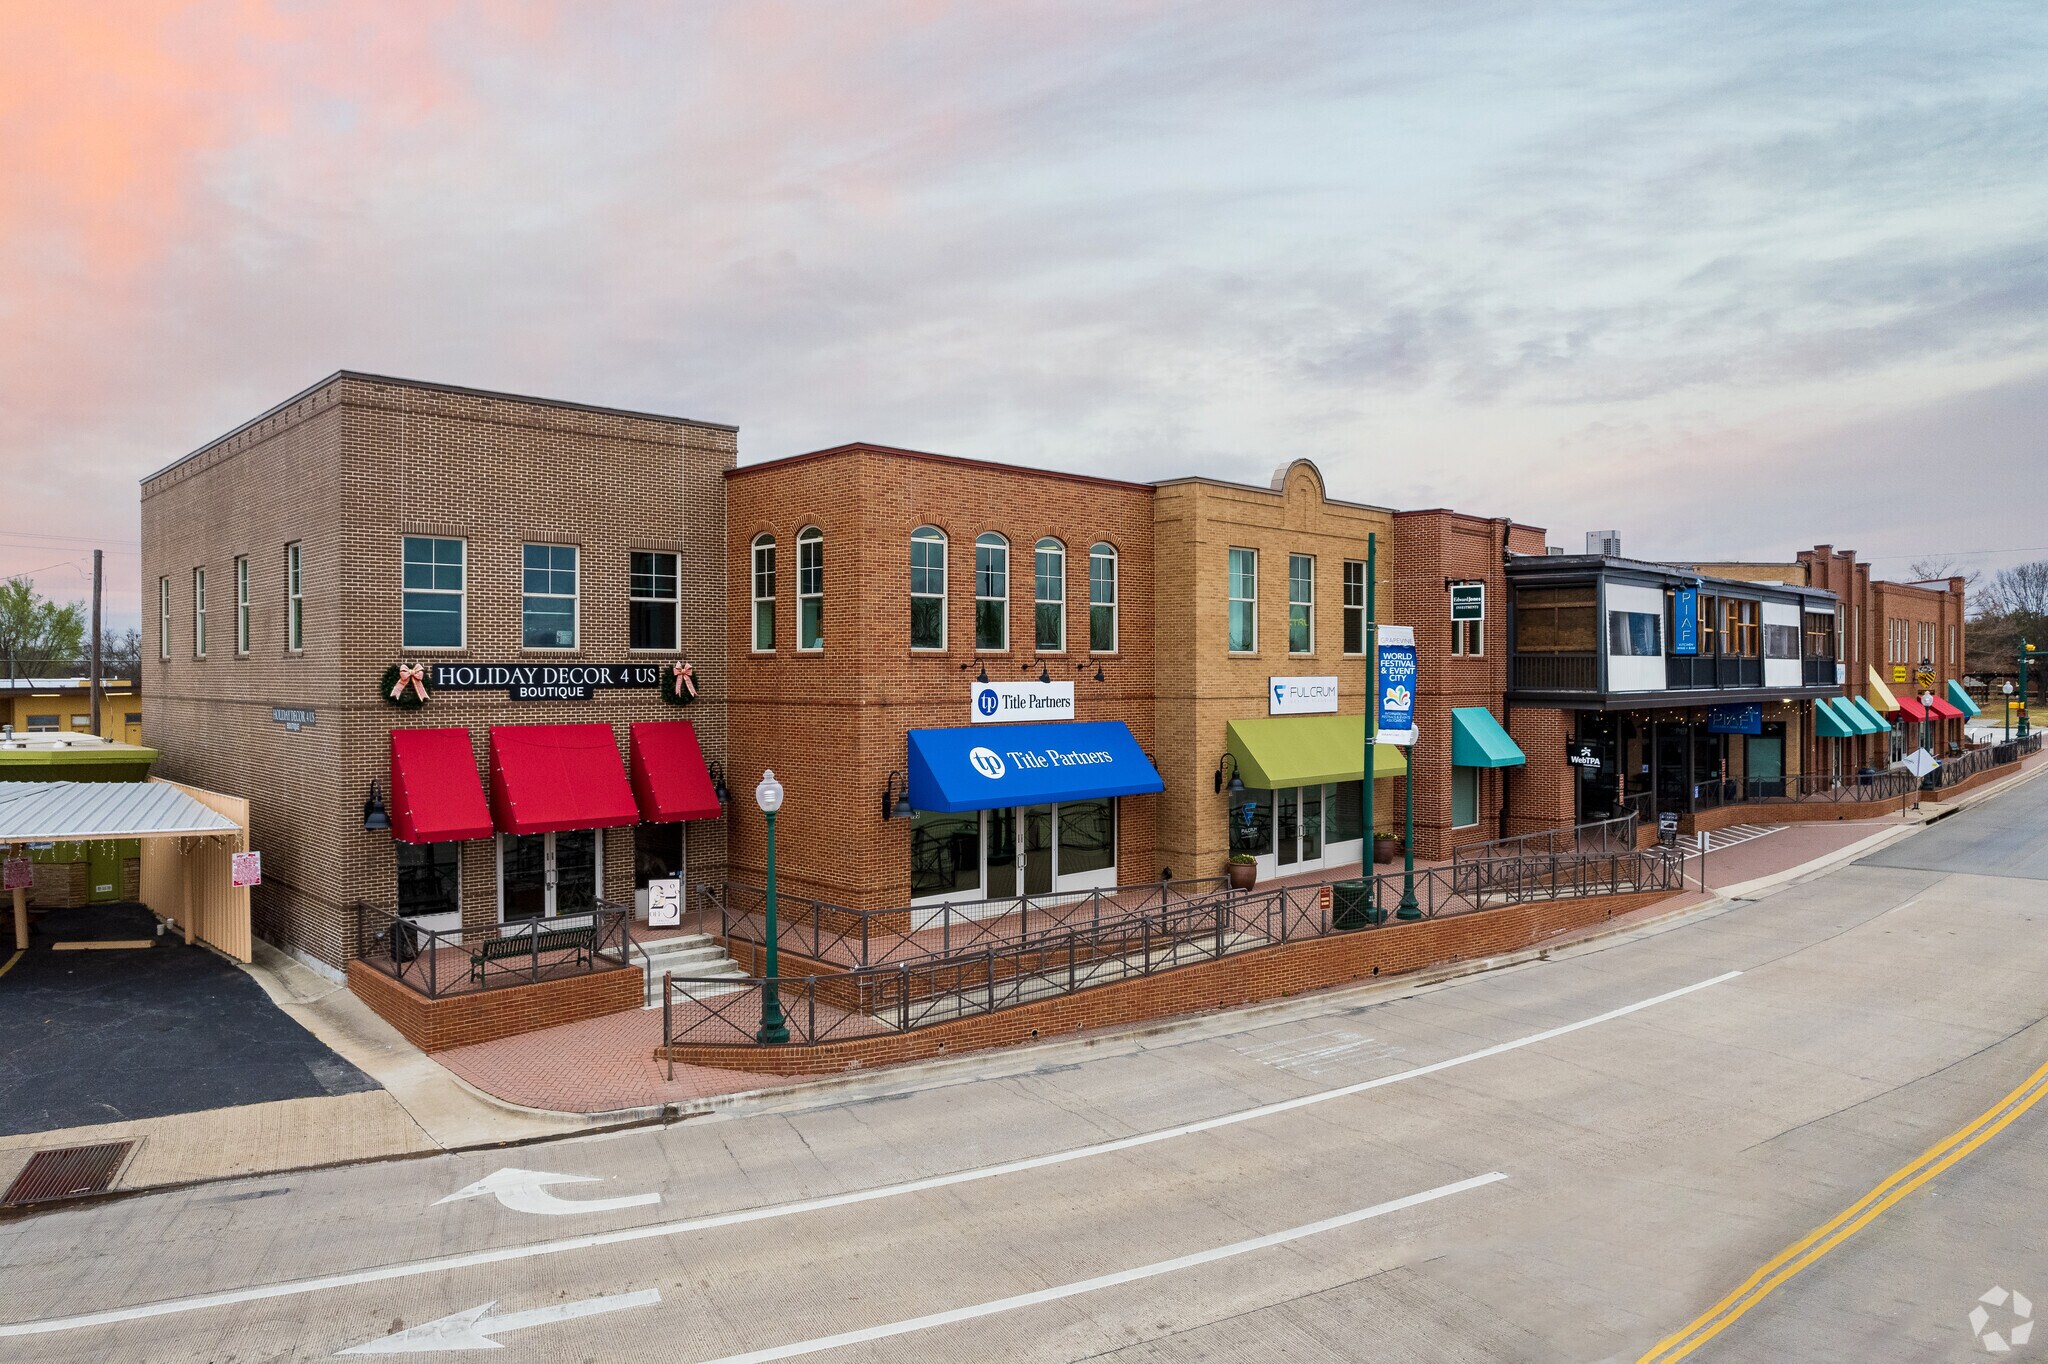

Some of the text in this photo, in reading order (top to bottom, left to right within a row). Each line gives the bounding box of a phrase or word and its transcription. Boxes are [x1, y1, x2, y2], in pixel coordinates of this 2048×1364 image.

[1682, 592, 1692, 641] PIAF
[1382, 652, 1413, 660] WORLD
[1380, 659, 1416, 668] FESTIVAL
[437, 667, 656, 686] HOLIDAY DECOR 4 US
[1380, 666, 1416, 675] & EVENT
[1388, 674, 1407, 682] CITY
[519, 687, 585, 699] BOUTIQUE
[1290, 686, 1336, 698] FULCRUM
[980, 692, 997, 713] tp
[1001, 694, 1071, 710] Title Partners
[973, 751, 1002, 776] tp
[1006, 749, 1114, 770] Title Partners
[1570, 755, 1601, 765] WebTPA
